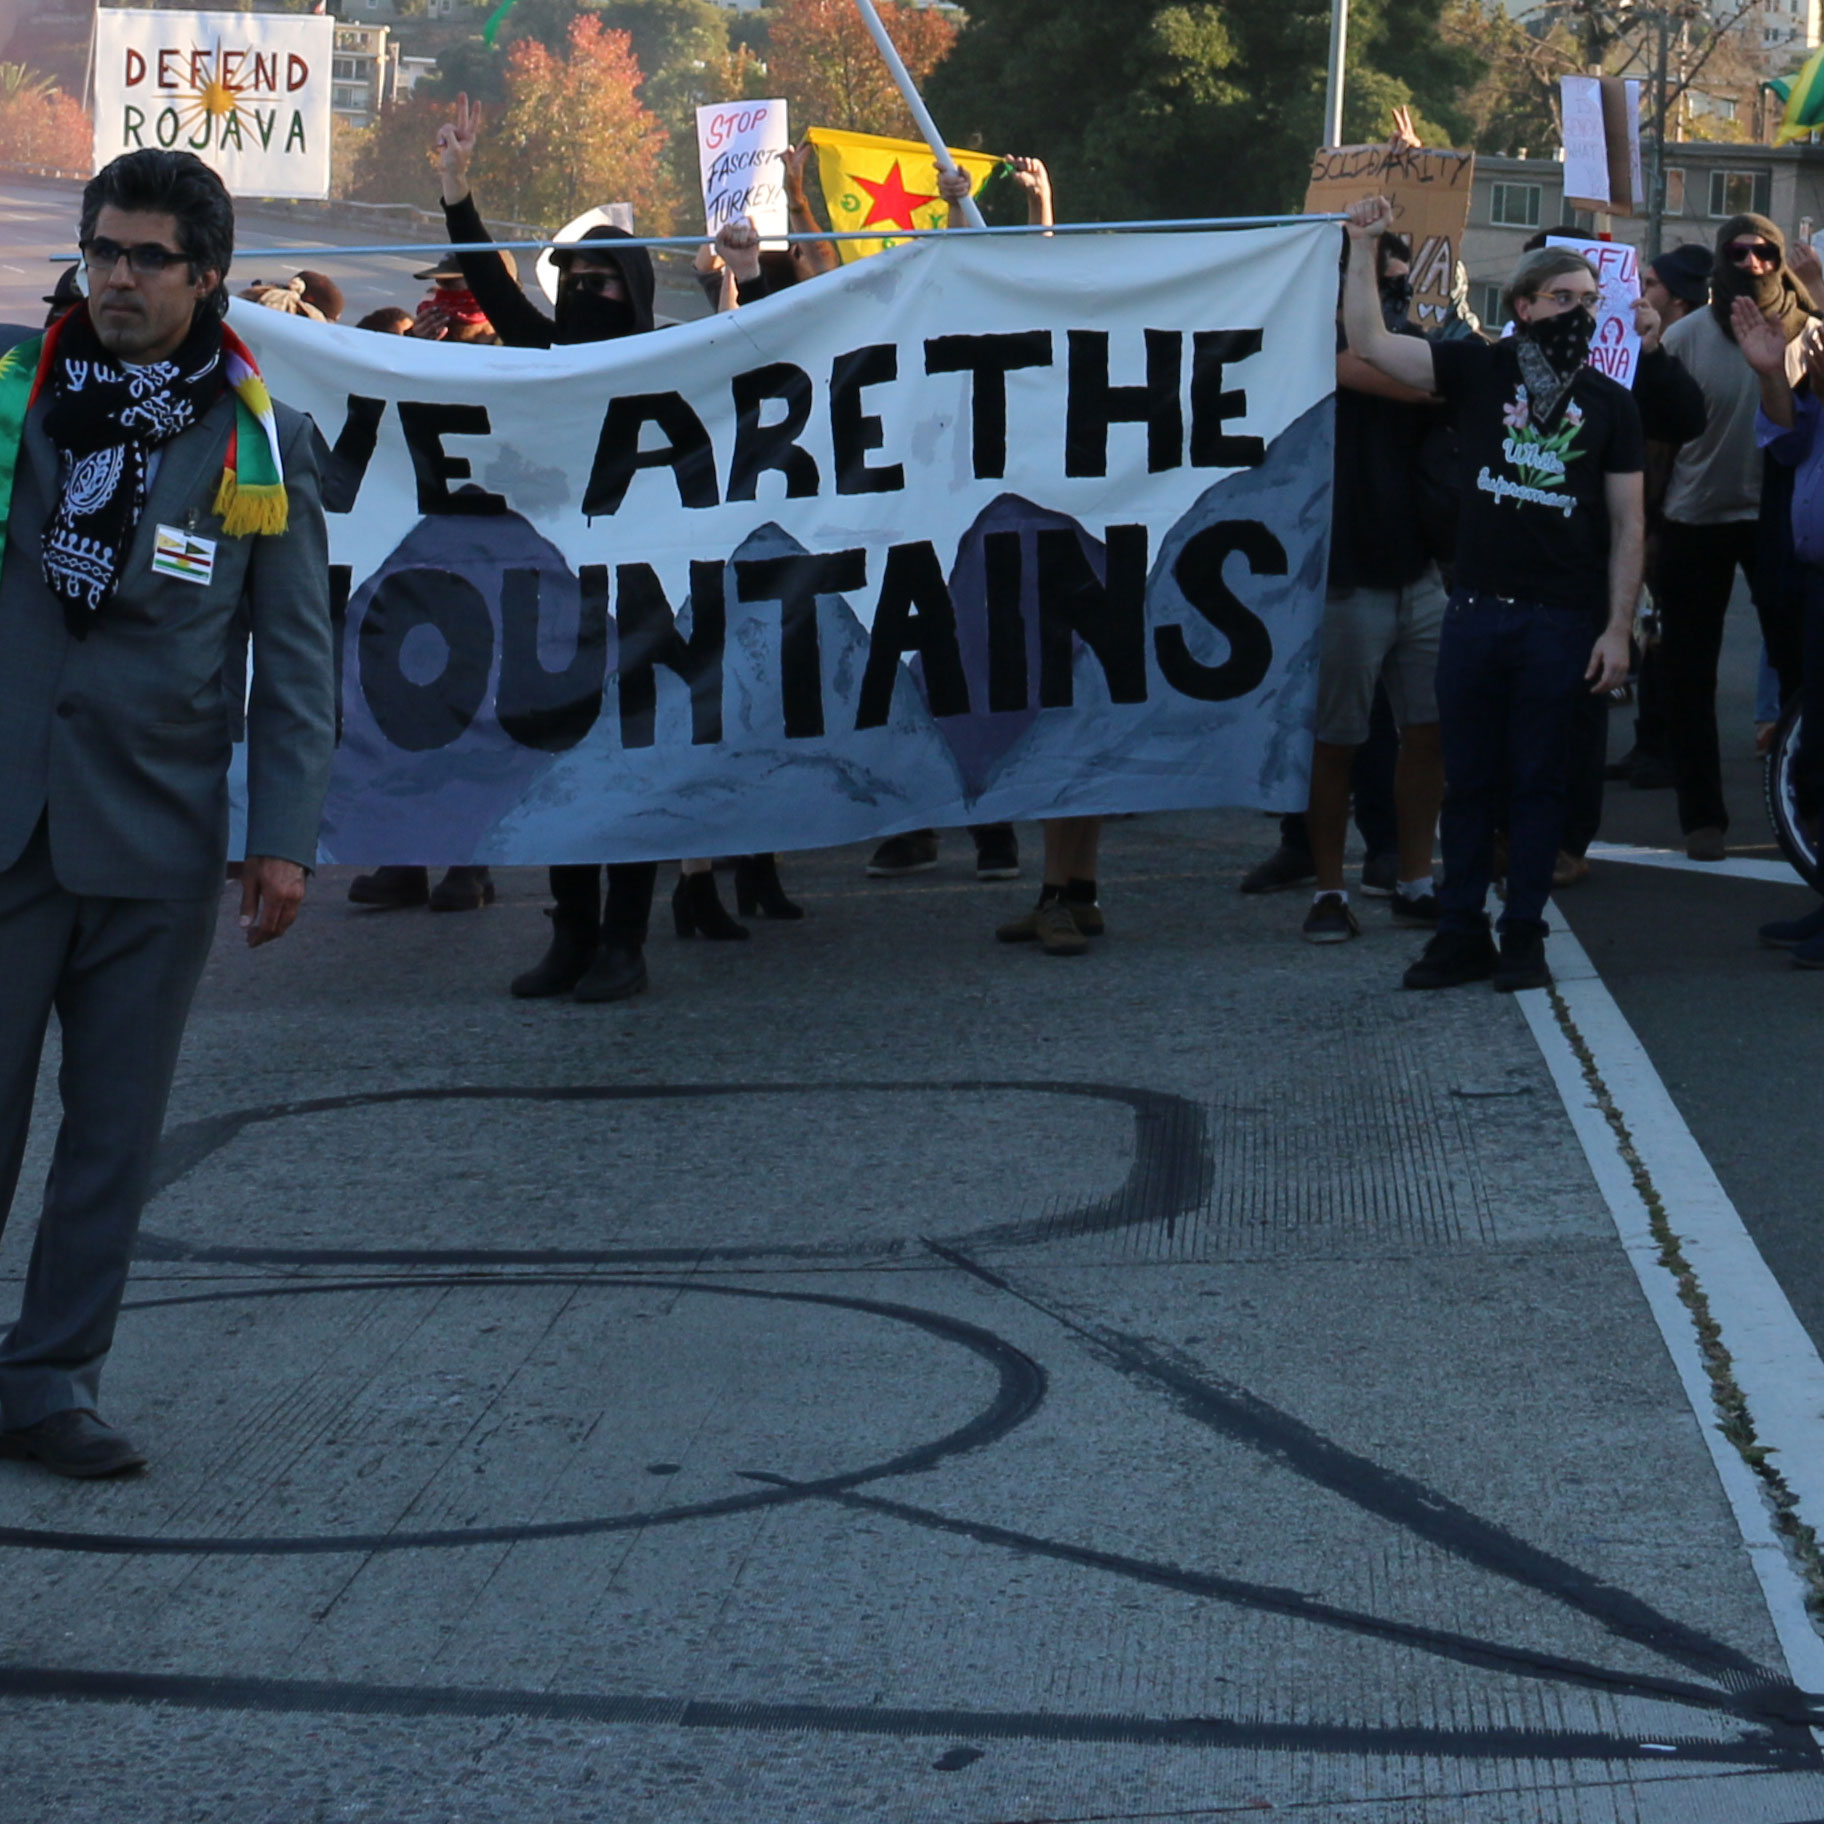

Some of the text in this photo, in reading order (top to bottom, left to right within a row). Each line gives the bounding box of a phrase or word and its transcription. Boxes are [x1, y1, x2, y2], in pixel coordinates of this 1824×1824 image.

[124, 47, 310, 93] DEFEND
[122, 104, 307, 154] ROJAVA
[705, 108, 769, 151] STOP
[706, 148, 778, 193] FASCIST
[1311, 148, 1473, 186] SOLIDARITY
[707, 182, 782, 231] TURKEY!
[582, 342, 905, 519] ARE
[923, 328, 1265, 480] THE
[1502, 437, 1566, 475] White
[330, 518, 1289, 752] OUNTAINS
